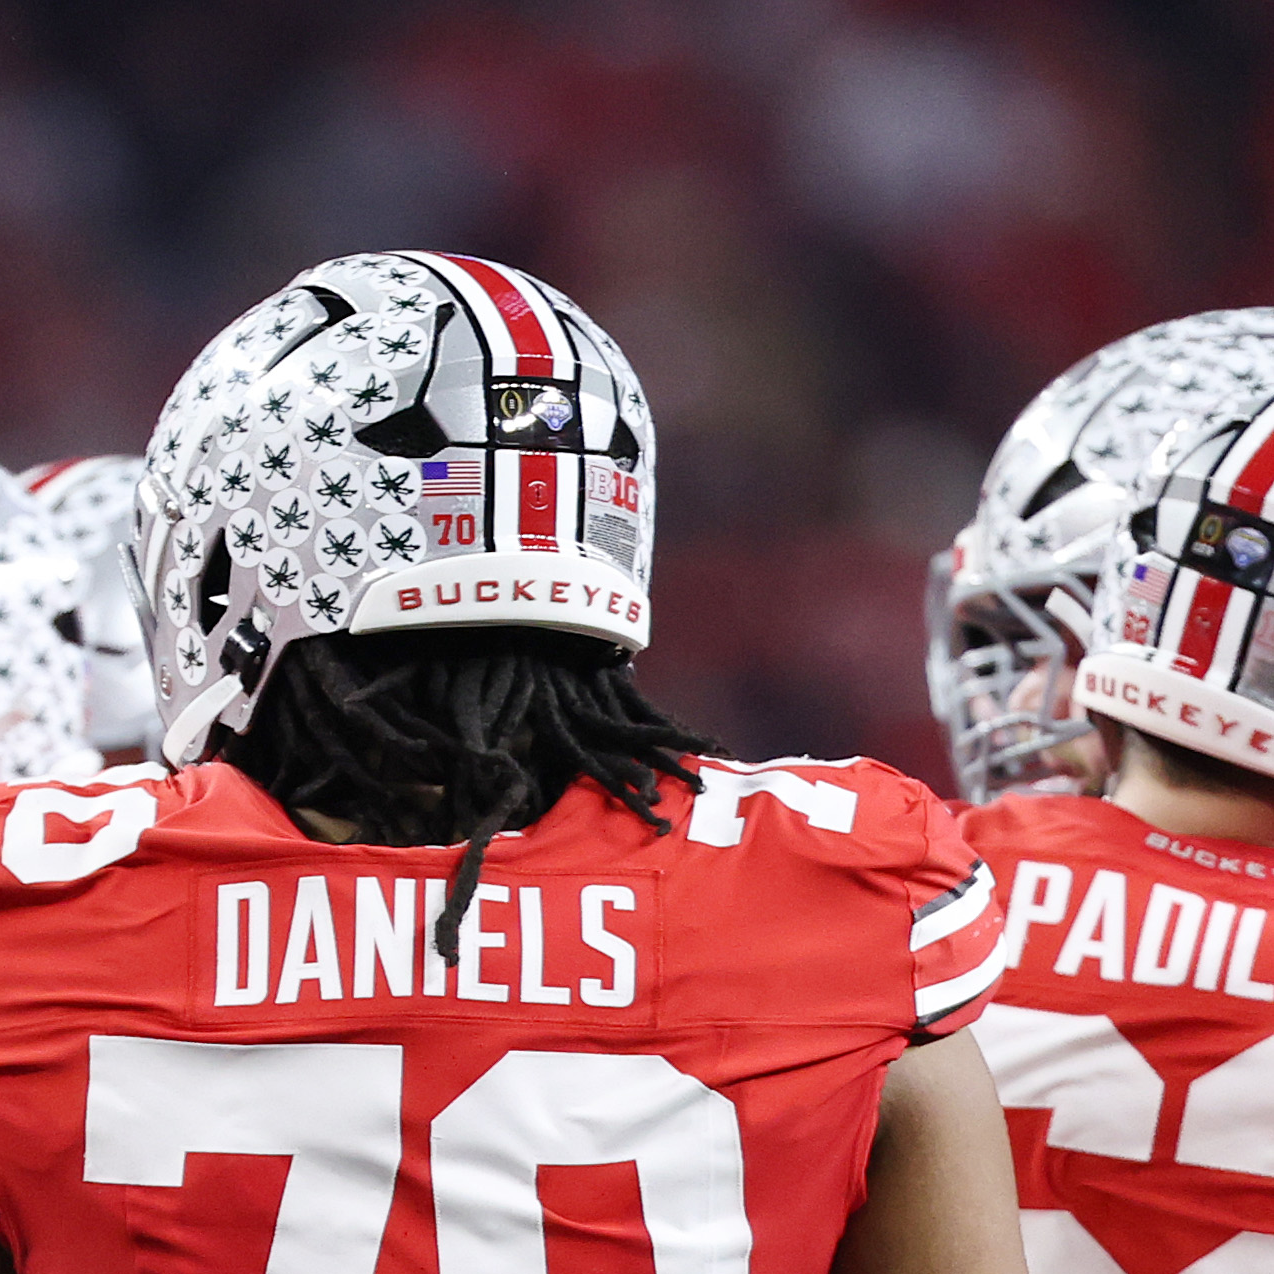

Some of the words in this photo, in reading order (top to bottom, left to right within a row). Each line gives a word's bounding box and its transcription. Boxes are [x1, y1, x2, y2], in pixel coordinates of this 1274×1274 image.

[433, 514, 475, 545] 70
[397, 579, 641, 624] BUCKEYES
[1145, 832, 1274, 878] BUCKE
[213, 874, 637, 1009] DANIELS
